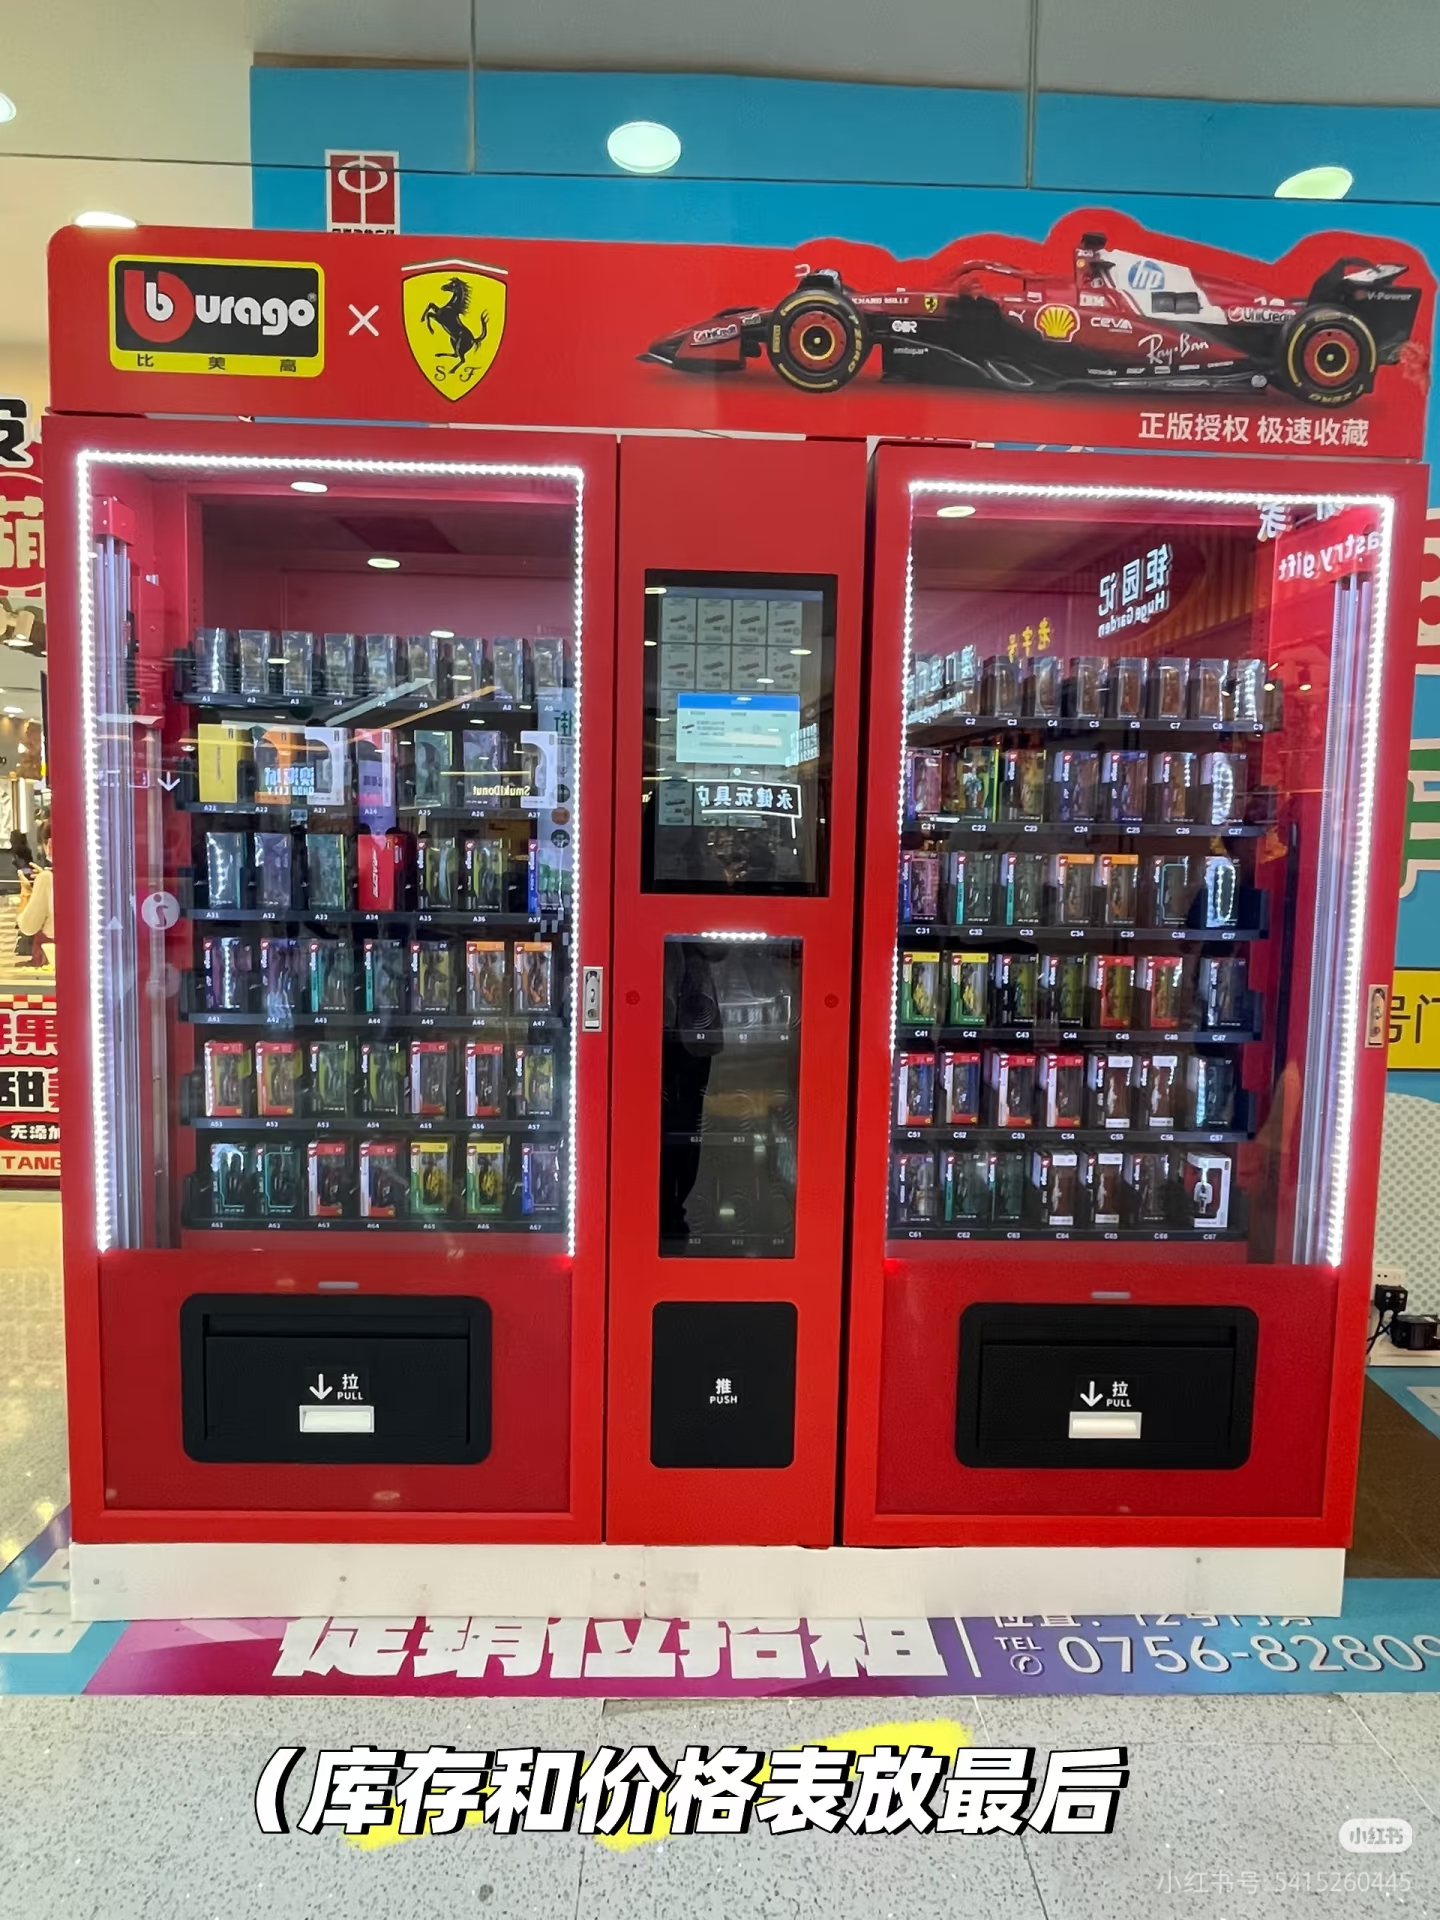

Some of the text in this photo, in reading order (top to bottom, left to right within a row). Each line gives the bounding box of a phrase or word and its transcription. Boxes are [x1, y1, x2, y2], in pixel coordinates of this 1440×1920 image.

[1131, 260, 1164, 290] hp
[137, 353, 296, 373] 比美高
[1138, 412, 1369, 447] 正版授权 极速收藏
[341, 1373, 360, 1390] 拉
[715, 1377, 732, 1395] 推
[1112, 1380, 1129, 1398] 拉
[337, 1391, 364, 1401] PULL
[709, 1395, 738, 1405] PUSH
[1106, 1398, 1132, 1408] PULL
[994, 1636, 1042, 1651] TEL
